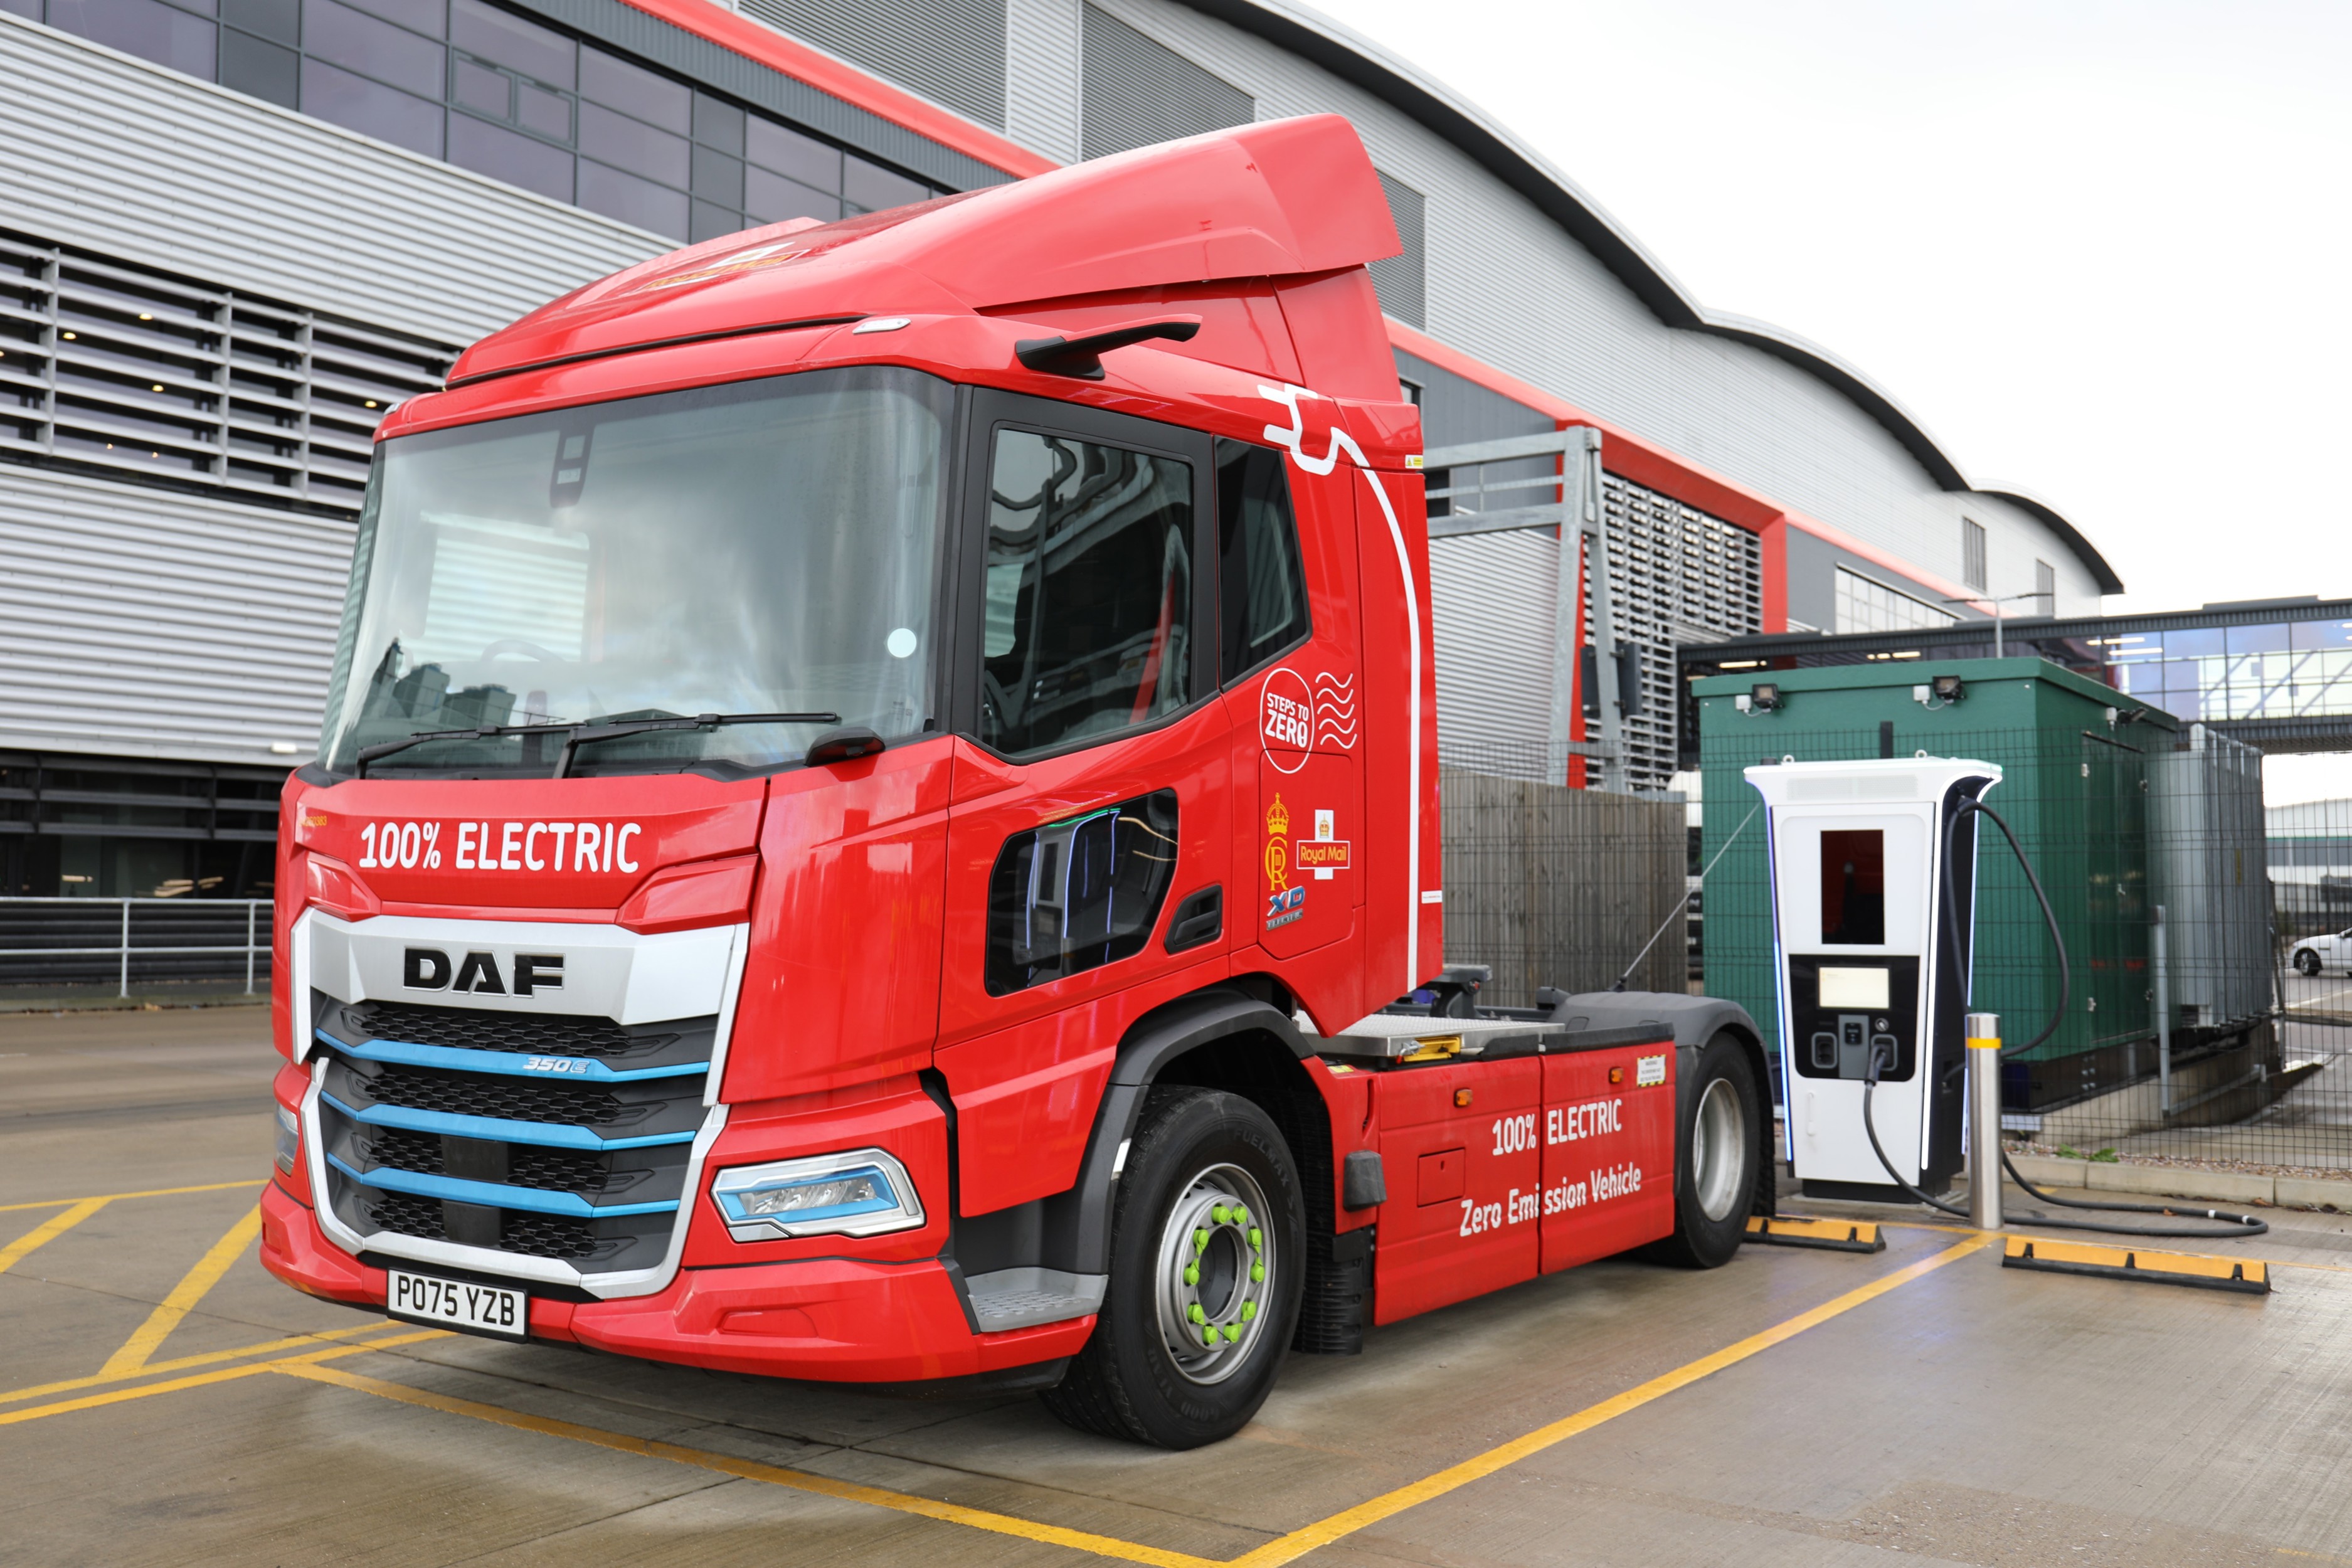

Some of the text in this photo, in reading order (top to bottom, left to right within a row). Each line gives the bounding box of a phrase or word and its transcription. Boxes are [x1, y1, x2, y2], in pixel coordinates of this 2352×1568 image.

[1264, 708, 1308, 748] ZERO
[1266, 692, 1309, 721] STEPS TO
[359, 822, 641, 874] 100% ELECTRIC
[1300, 845, 1347, 864] Royal Mail
[1267, 886, 1305, 916] XD
[401, 945, 566, 999] DAF
[1491, 1098, 1623, 1156] 100% ELECTRIC
[1459, 1161, 1641, 1237] Zero Emission Vehicle
[398, 1274, 515, 1327] PO75 YZB
